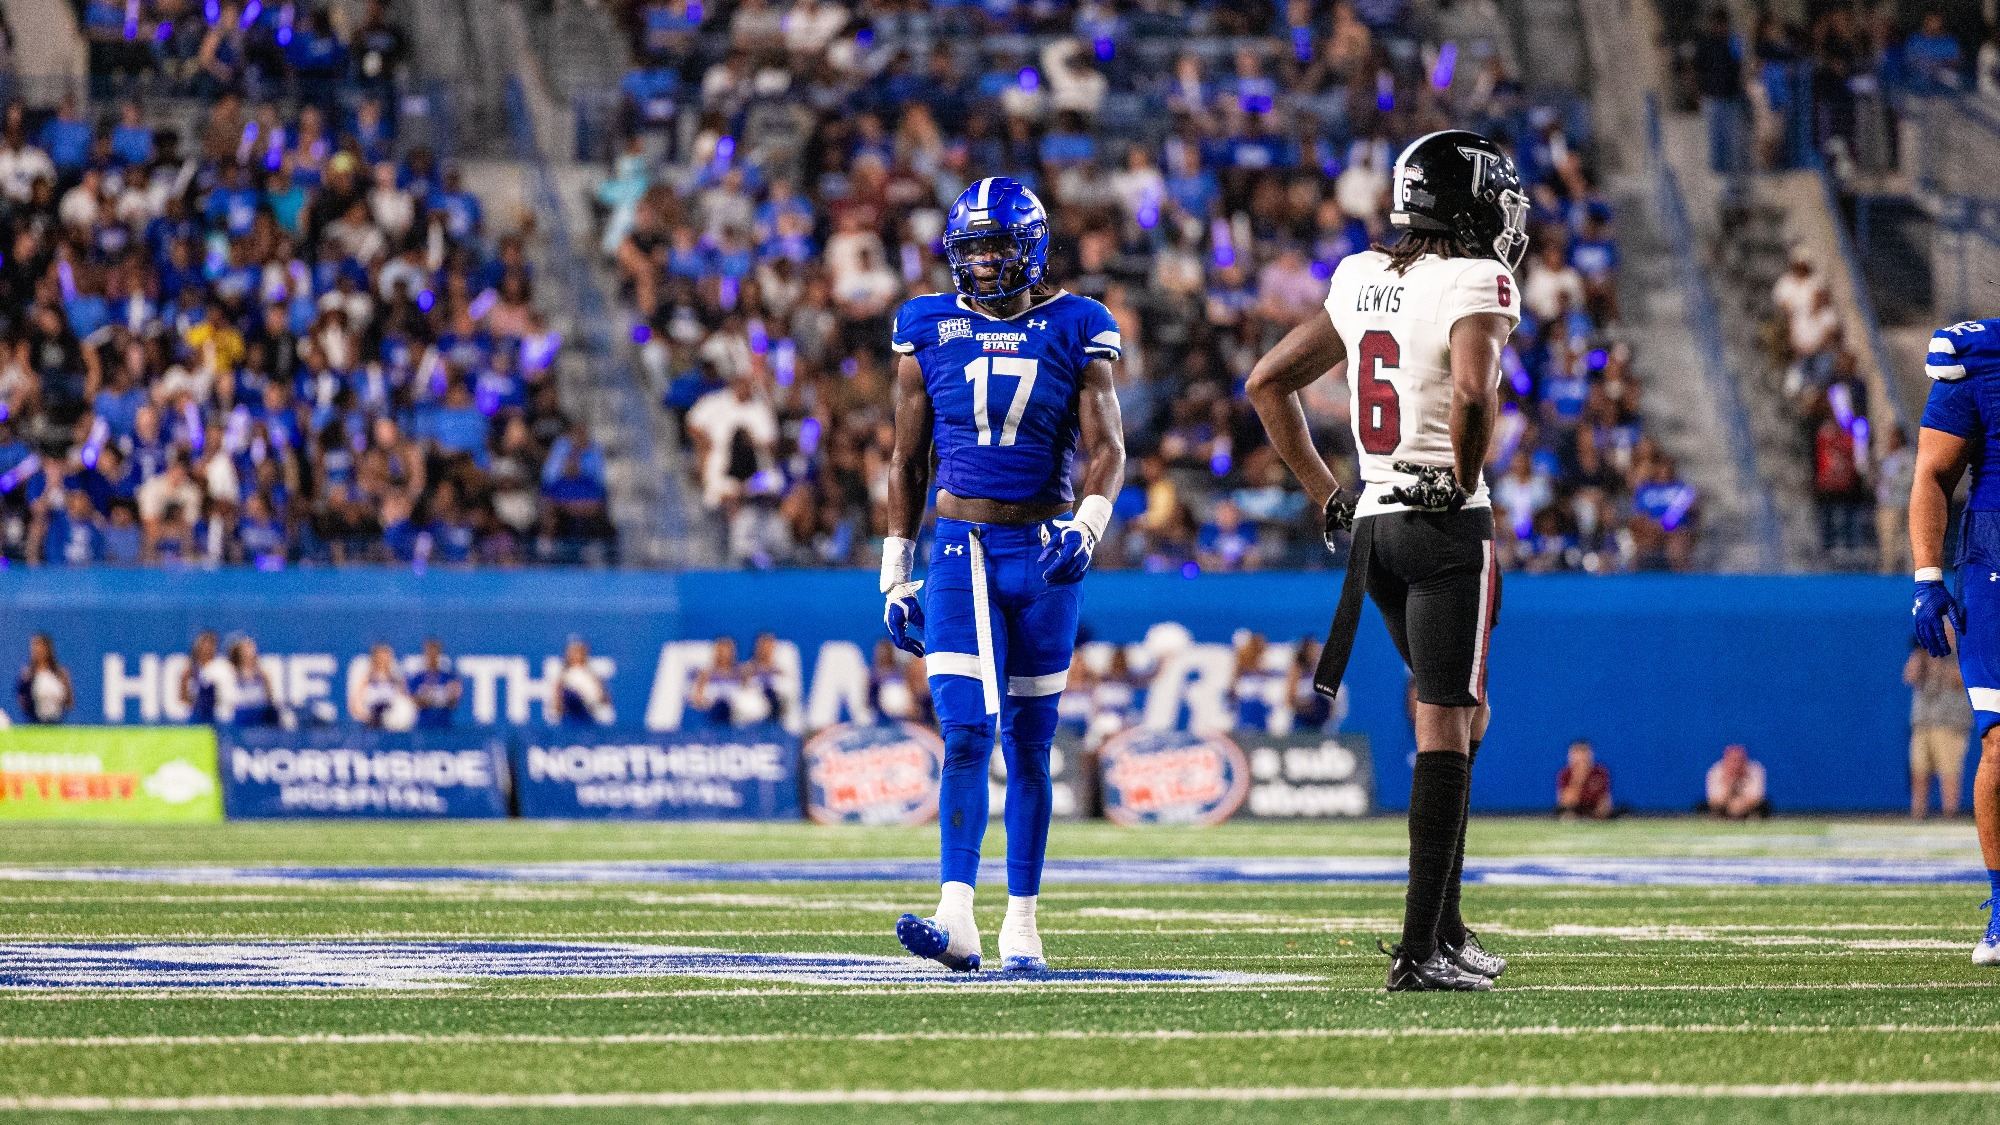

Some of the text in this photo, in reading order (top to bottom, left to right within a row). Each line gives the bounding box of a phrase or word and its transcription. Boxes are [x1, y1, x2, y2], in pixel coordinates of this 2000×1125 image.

[1403, 179, 1412, 203] 6
[1356, 285, 1405, 312] LEWIS
[1496, 275, 1511, 308] 6
[975, 332, 1028, 342] GEORGIA
[982, 341, 1020, 351] STATE
[963, 356, 1039, 447] 17
[1358, 330, 1401, 455] 6
[232, 747, 490, 787] NORTHSIDE
[528, 744, 784, 782] NORTHSIDE
